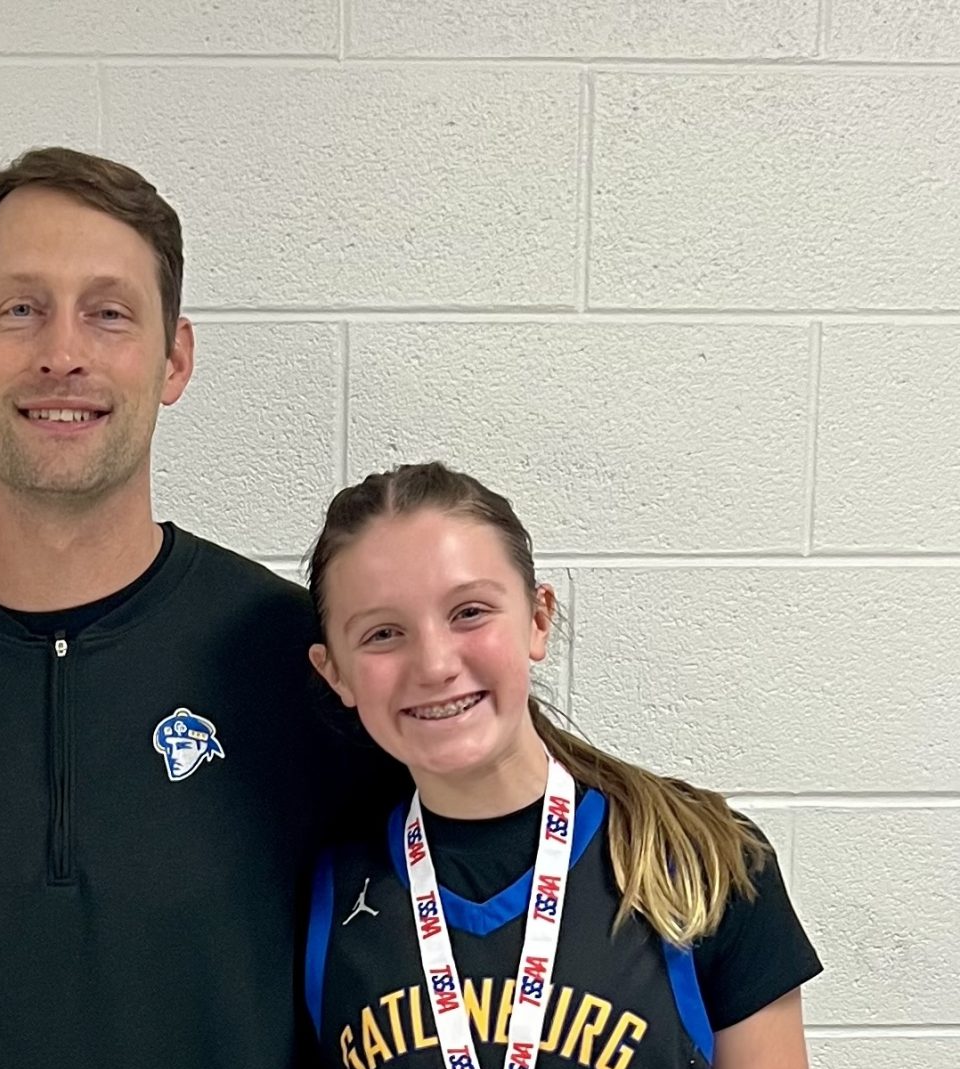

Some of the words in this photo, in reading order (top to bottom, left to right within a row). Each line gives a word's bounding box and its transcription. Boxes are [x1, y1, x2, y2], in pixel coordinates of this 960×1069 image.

[545, 796, 571, 844] TSSAA
[416, 891, 442, 940] TSSAA
[533, 875, 561, 923] TSSAA
[429, 965, 460, 1015] TSSAA
[519, 956, 548, 1007] TSSAA
